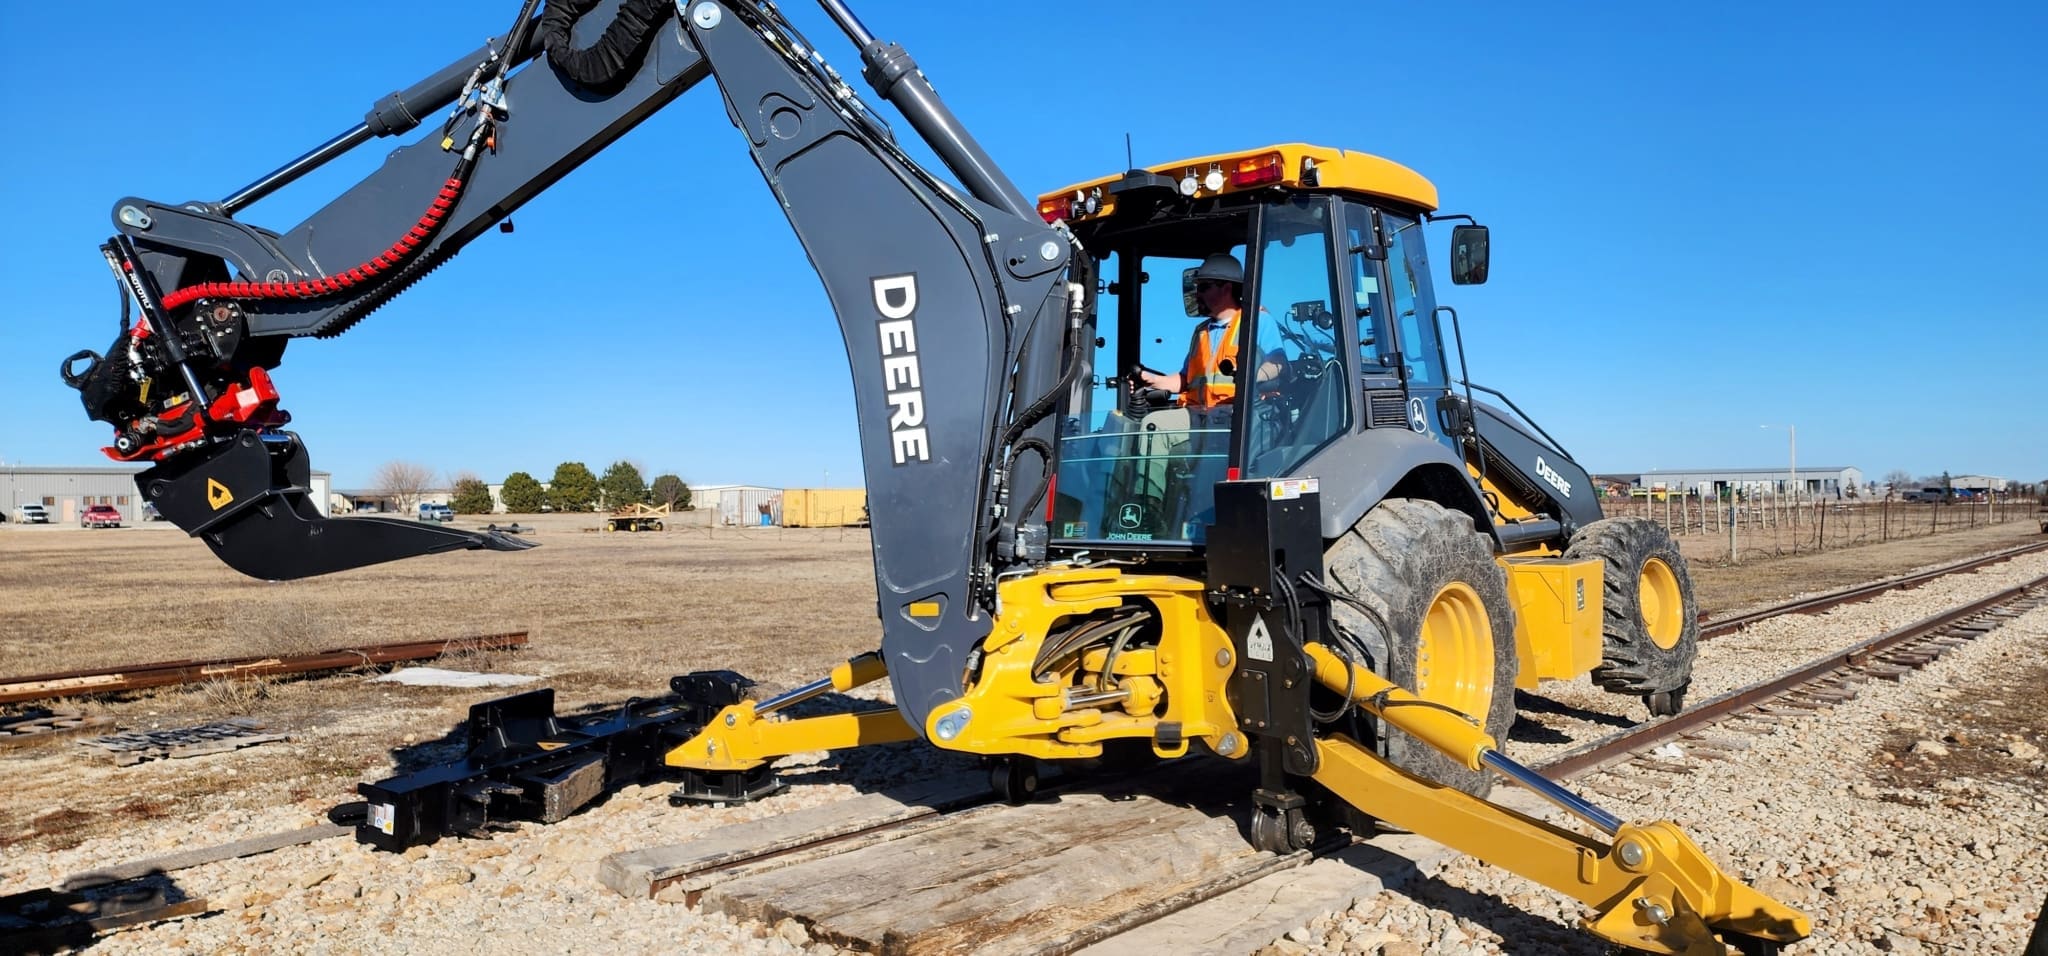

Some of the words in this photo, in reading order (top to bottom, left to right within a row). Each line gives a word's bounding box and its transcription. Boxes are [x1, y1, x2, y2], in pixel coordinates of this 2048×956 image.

[873, 275, 930, 464] DEERE
[1535, 455, 1571, 498] DEERE
[1106, 532, 1126, 541] JOHN
[1127, 532, 1153, 541] DEERE
